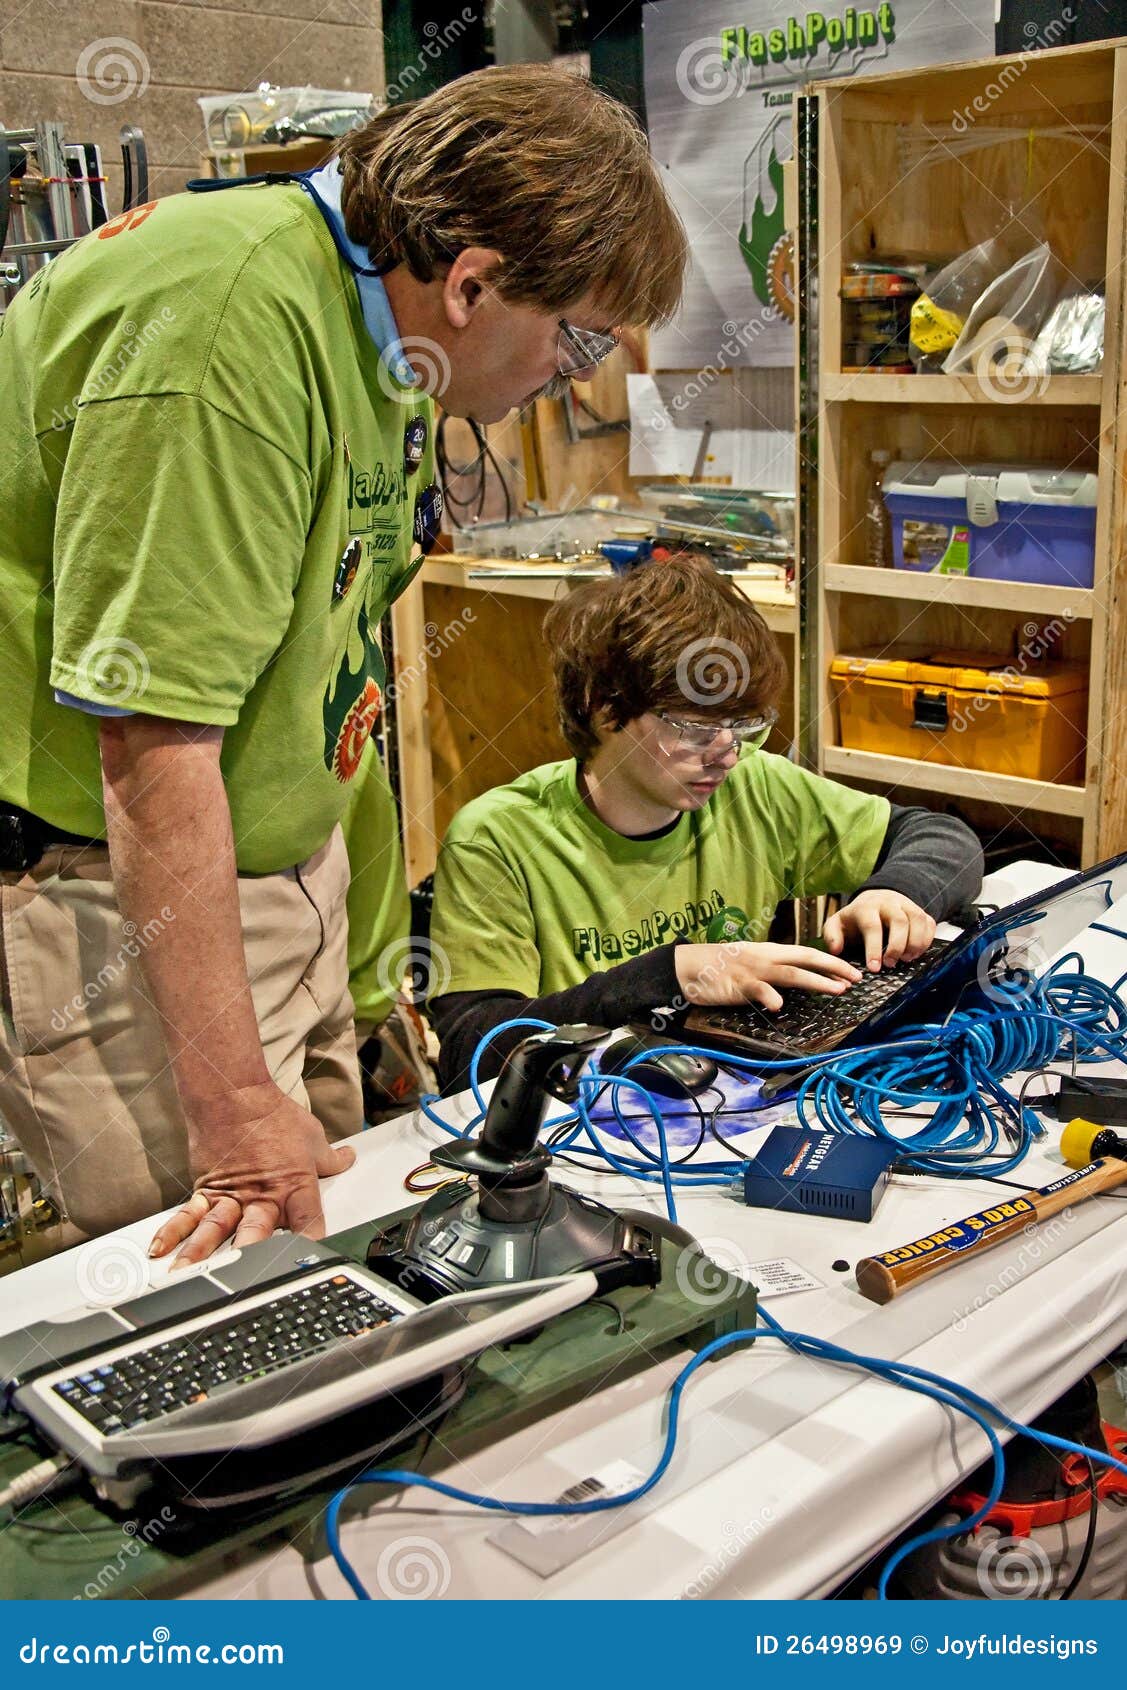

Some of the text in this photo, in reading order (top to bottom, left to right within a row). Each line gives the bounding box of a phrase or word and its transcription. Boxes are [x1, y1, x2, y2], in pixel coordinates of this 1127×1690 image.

[720, 2, 896, 71] FlashPoint
[762, 91, 793, 108] Team
[805, 1133, 835, 1171] NETGEAR
[1046, 1163, 1098, 1193] VAUGHAN
[877, 1199, 1032, 1265] PRO'S CHOICE
